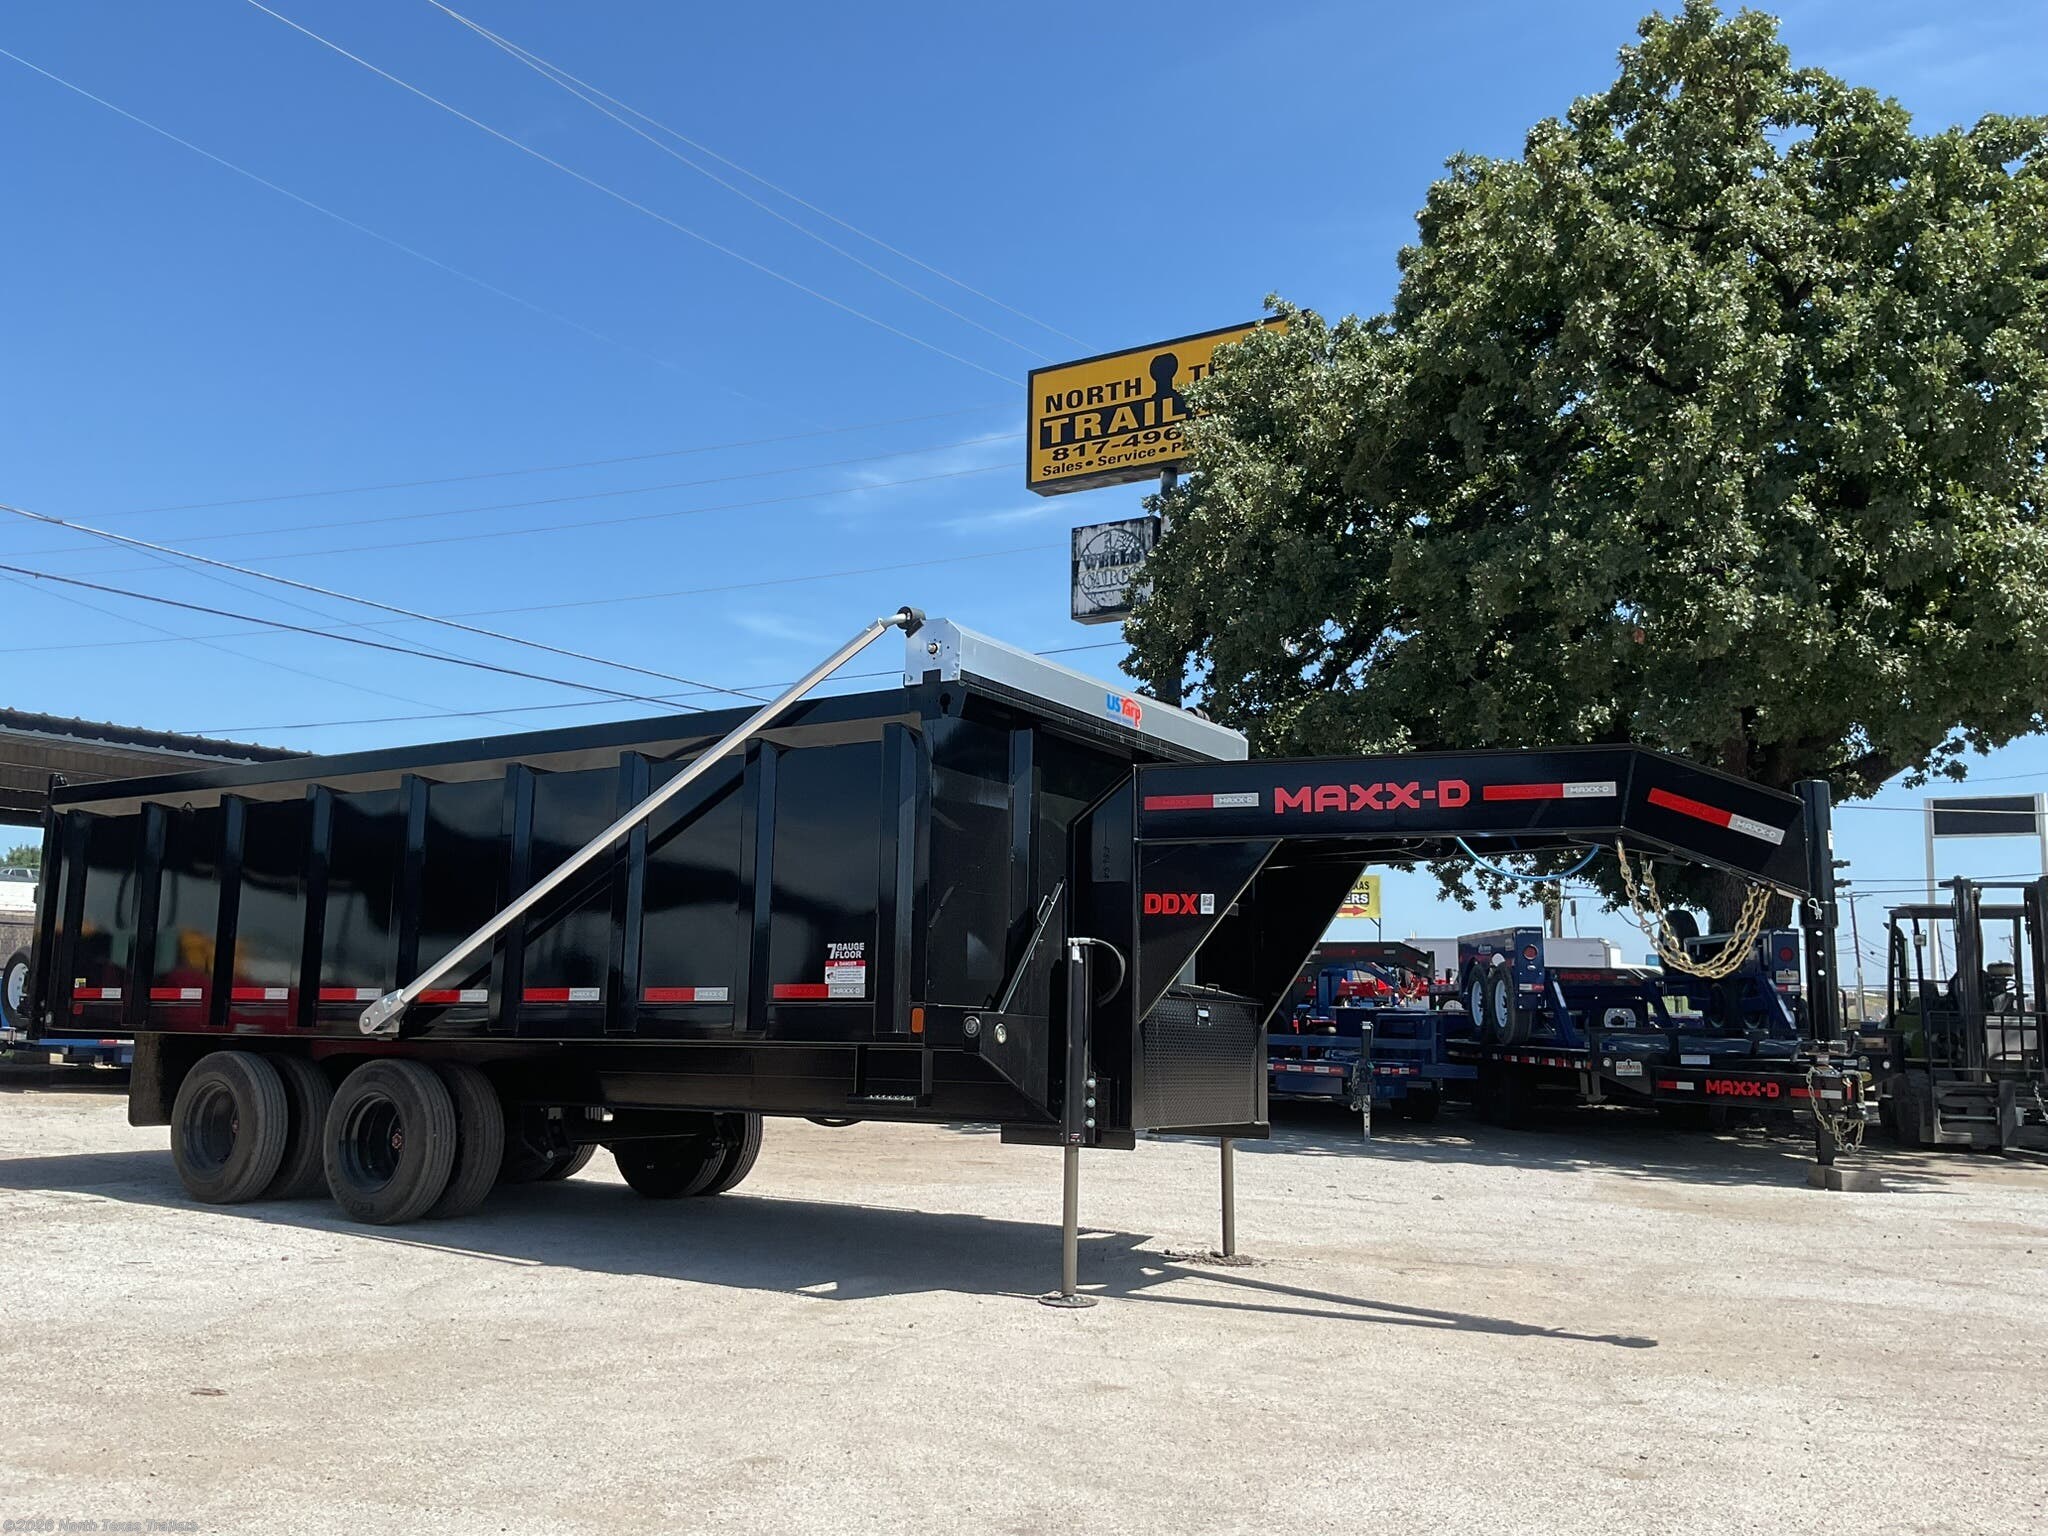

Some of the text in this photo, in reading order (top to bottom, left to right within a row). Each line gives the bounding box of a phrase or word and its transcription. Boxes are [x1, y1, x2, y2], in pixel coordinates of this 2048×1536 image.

[1045, 377, 1142, 413] NORTH
[1043, 397, 1212, 444] TRAIL
[1042, 460, 1083, 476] Sales
[1097, 449, 1156, 466] Service
[1274, 779, 1471, 814] MAXX-D
[1143, 893, 1199, 914] DDX
[827, 942, 865, 959] 7 GAUGE
[835, 950, 862, 959] FLOOR
[1705, 1079, 1780, 1098] MAXX-D
